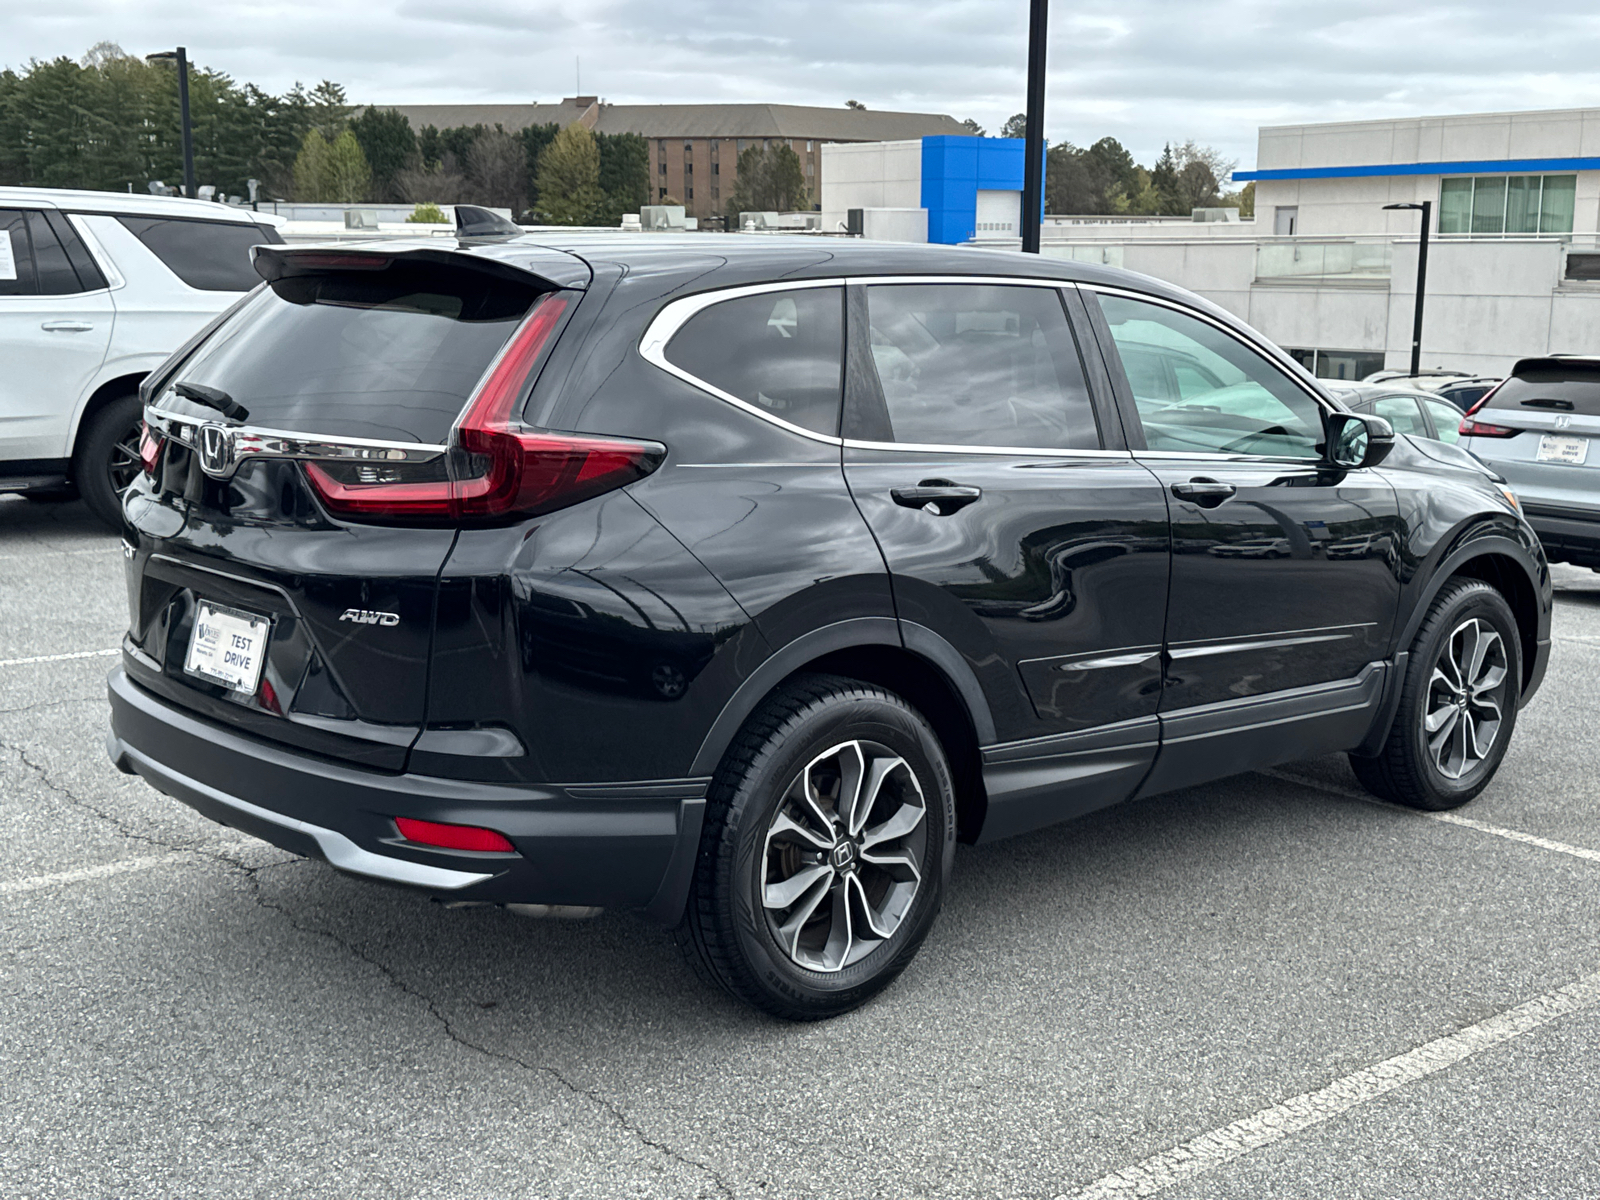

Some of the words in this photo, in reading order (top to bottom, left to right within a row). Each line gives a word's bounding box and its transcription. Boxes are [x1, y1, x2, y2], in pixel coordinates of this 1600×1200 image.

[339, 608, 400, 627] AWD
[232, 634, 253, 651] TEST
[224, 651, 251, 670] DRIVE
